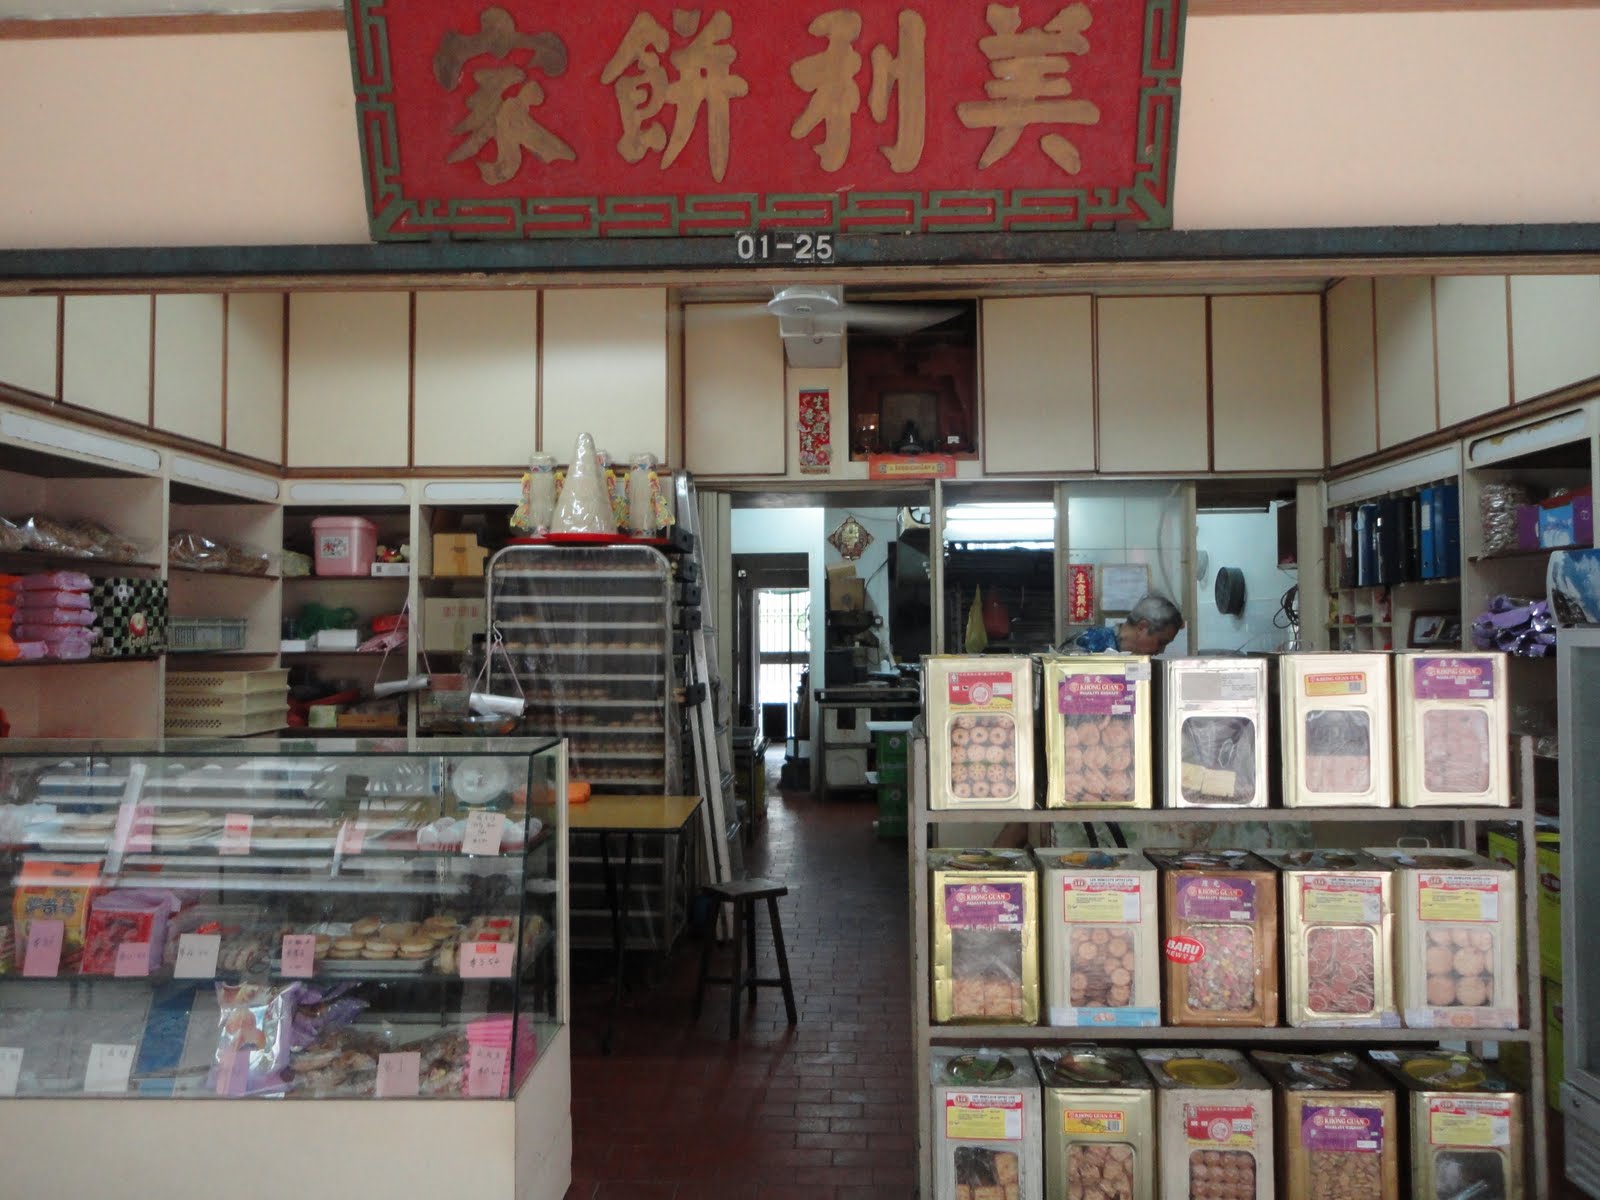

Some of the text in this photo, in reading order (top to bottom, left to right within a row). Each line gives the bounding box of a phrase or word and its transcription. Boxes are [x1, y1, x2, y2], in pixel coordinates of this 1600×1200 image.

[737, 234, 832, 260] 01-25
[1436, 667, 1476, 675] KHONG GUAN
[1080, 683, 1119, 691] KHONG GUAN
[1198, 888, 1219, 896] KHONG
[988, 893, 1006, 901] GUAN
[1166, 939, 1200, 955] BARU
[1165, 948, 1183, 958] NEW
[1324, 1117, 1364, 1125] KHONG GUAN
